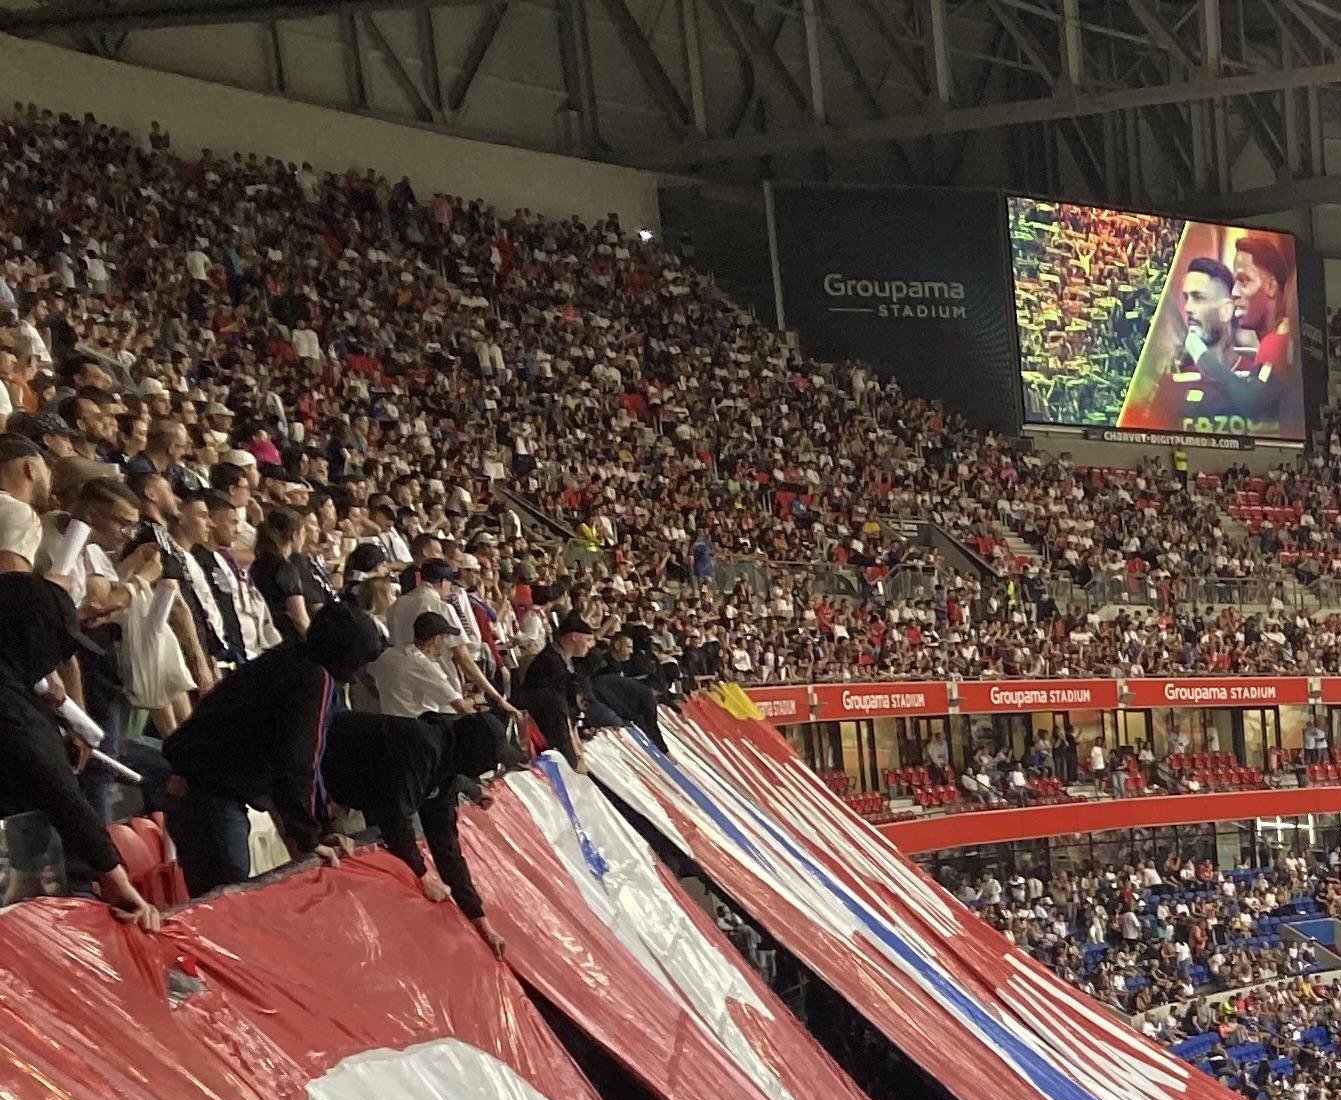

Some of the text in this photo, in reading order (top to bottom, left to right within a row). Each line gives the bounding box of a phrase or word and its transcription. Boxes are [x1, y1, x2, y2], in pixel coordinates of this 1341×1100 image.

[823, 273, 966, 300] Groupama
[878, 304, 967, 319] STADIUM
[843, 690, 925, 712] Groupama STADIUM
[990, 686, 1091, 707] Groupama STADIUM
[1164, 683, 1276, 702] Groupama STADIUM
